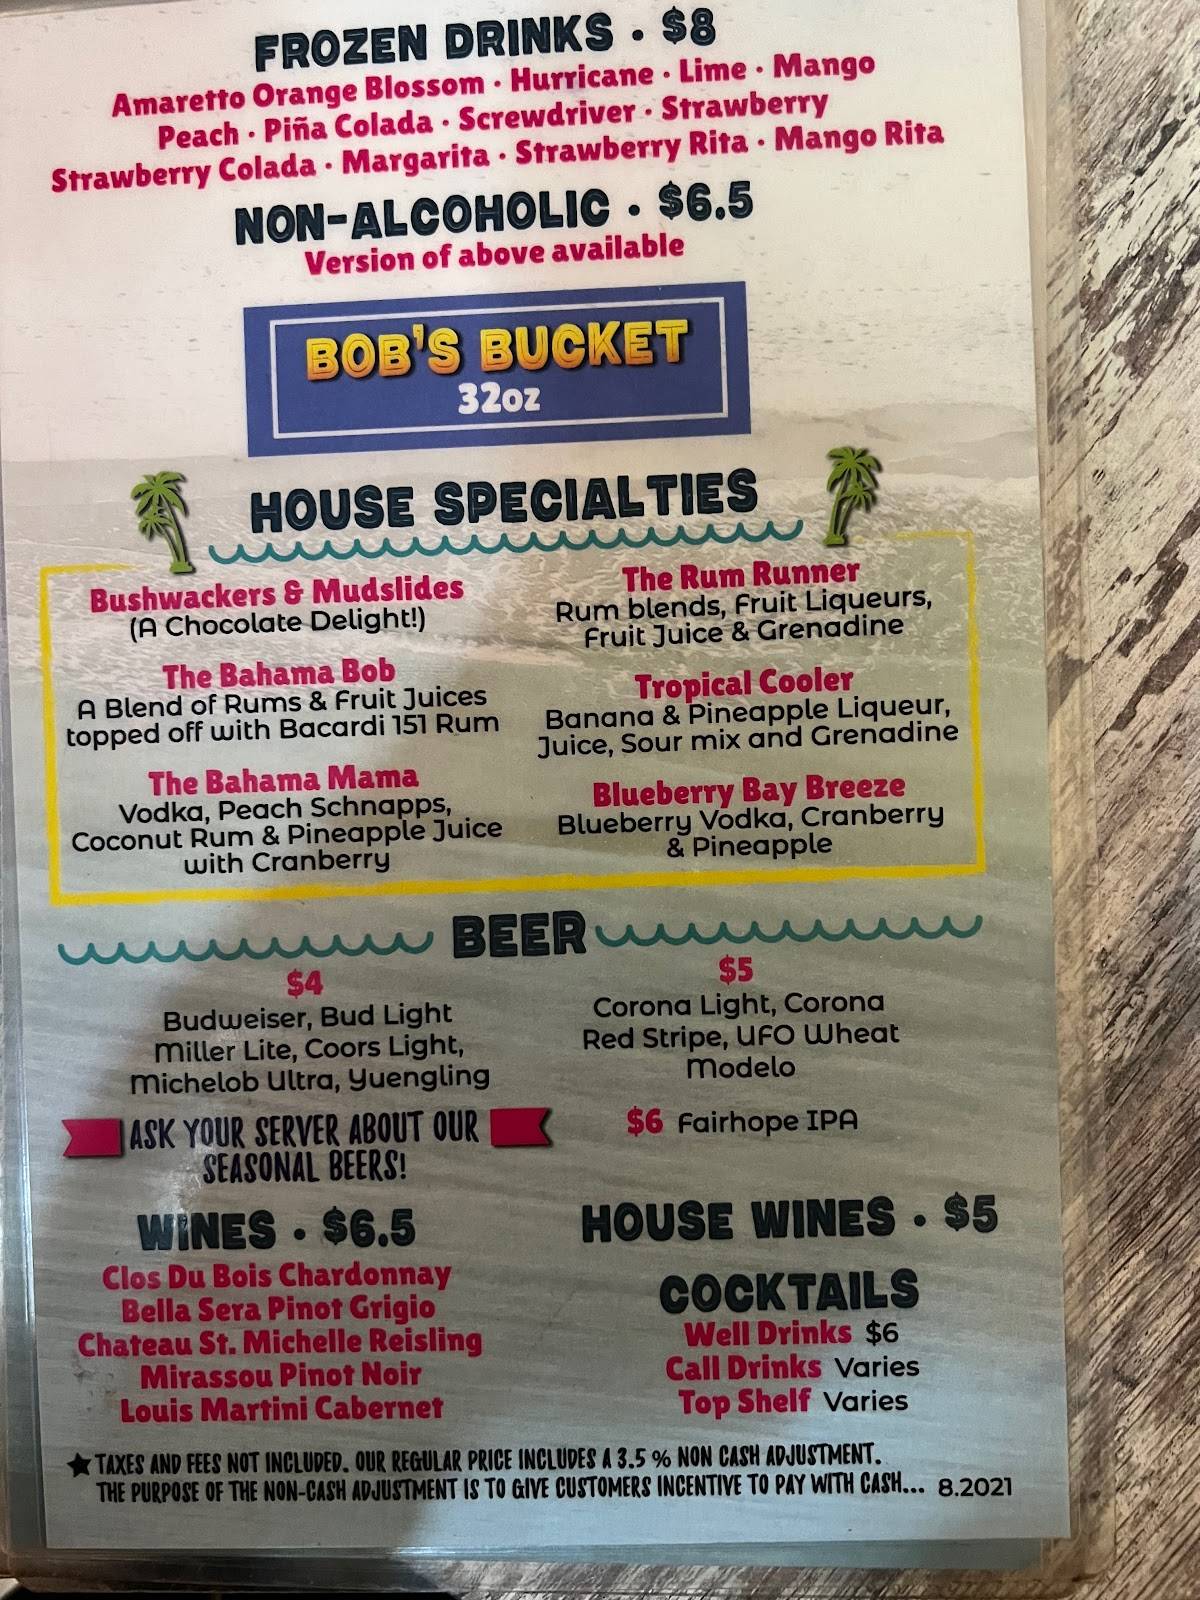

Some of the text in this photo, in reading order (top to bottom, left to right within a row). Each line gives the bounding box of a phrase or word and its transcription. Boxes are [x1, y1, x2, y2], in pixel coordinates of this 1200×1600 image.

[255, 6, 716, 72] FROZEN DRINKS $8
[112, 53, 875, 117] Amaretto Orange Blossom Hurricane Lime Mango
[159, 91, 828, 150] Peach Piña Colada Screwdriver Strawberry
[235, 180, 753, 245] NON-ALCOHOLIC $6.5
[305, 233, 684, 275] Version of above available
[307, 320, 687, 379] BOB'S BUCKET
[459, 382, 540, 414] 32oz
[251, 468, 758, 533] HOUSE SPECIALTIES
[622, 561, 860, 592] The Rum Runner
[91, 575, 464, 613] Bushwackers Mudslides
[557, 589, 931, 622] Rum blends, Fruit Liqueurs,
[131, 606, 425, 643] (A Chocolate Delight!)
[162, 657, 395, 689] The Bahama Bob
[635, 667, 853, 703] Tropical Cooler
[546, 696, 950, 729] Banana Pineapple Liqueur,
[67, 714, 499, 751] topped off with Bacardi 151 Rum
[148, 765, 419, 796] The Bahama Mama
[593, 775, 905, 808] Blueberry Bay Breeze
[119, 796, 451, 824] Vodka, Peach Schnapps,
[559, 804, 943, 836] Blueberry Vodka, Cranberry
[185, 849, 389, 874] with Cranberry
[453, 910, 586, 959] BEER
[287, 969, 323, 999] $4
[719, 954, 753, 985] $5
[164, 1002, 452, 1031] Budweiser, Bud Light
[155, 1033, 463, 1063] Miller Lite, Coors Light,
[583, 1022, 899, 1052] Red Stripe, UFO Wheat
[131, 1064, 489, 1094] Michelob Ultra, Yuengling
[687, 1056, 795, 1079] Modelo
[130, 1110, 479, 1150] ASK YOUR SERVER ABOUT OUR
[628, 1106, 857, 1137] $6 Fairhope IPA
[203, 1149, 406, 1184] SEASONAL BEERS!
[137, 1206, 415, 1251] WINES $6.5
[582, 1192, 998, 1243] HOUSE WINES $5
[103, 1261, 452, 1290] Clos Du Bois Chardonnay
[660, 1268, 919, 1314] COCKTAILS
[122, 1294, 435, 1325] Bella Sera Pinot Grigio
[79, 1327, 482, 1357] Chateau St. Michelle Reisling
[684, 1319, 898, 1347] Well Drinks $6
[121, 1395, 443, 1423] Louis Martini Cabernet
[678, 1387, 908, 1420] Top Shelf Varies
[95, 1442, 881, 1475] TAXES AND FEES NOT INCLUDED. OUR REGULAR PRICE INCLUDES A 3.5 NON CASH ADJUSTMENT.
[96, 1471, 1011, 1503] THE PURPOSE OF THE NON-CASH ADJUSTMENT IS TO GIVE CUSTOMERS INCENTIVE TO PAY WITH CASH... 8.2021
